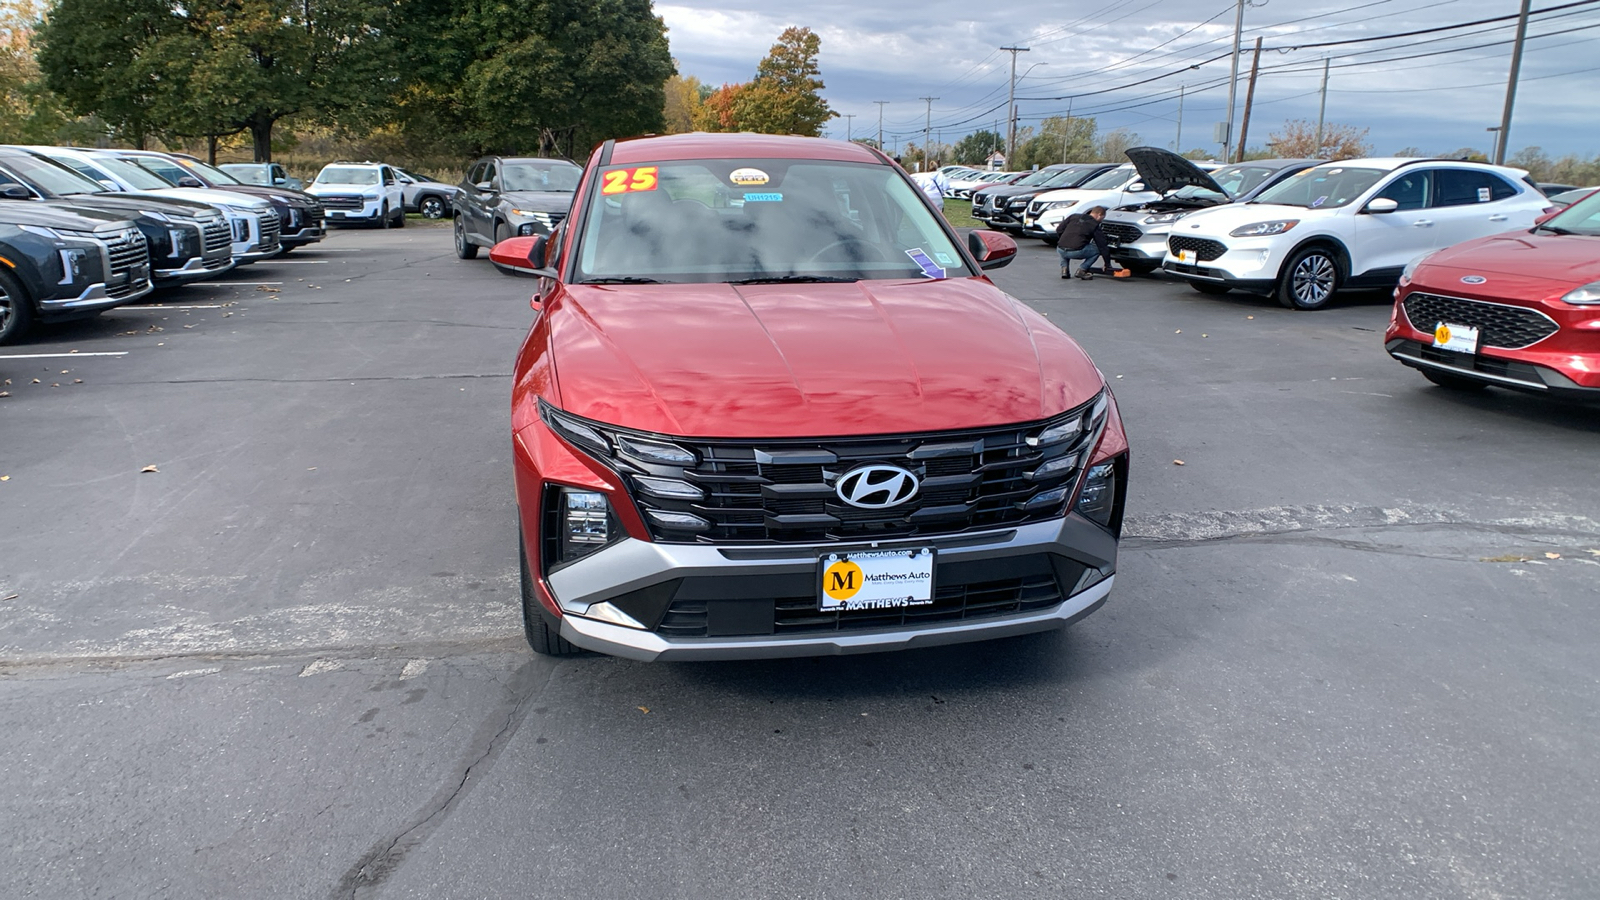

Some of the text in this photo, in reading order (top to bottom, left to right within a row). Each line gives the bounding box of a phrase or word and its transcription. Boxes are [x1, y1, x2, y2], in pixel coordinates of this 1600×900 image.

[603, 167, 656, 193] 25
[847, 550, 912, 558] MatthewsAuto.com
[830, 570, 856, 591] M
[865, 572, 907, 581] Matthews
[908, 571, 930, 579] Auto
[846, 597, 908, 610] MATTHEWS
